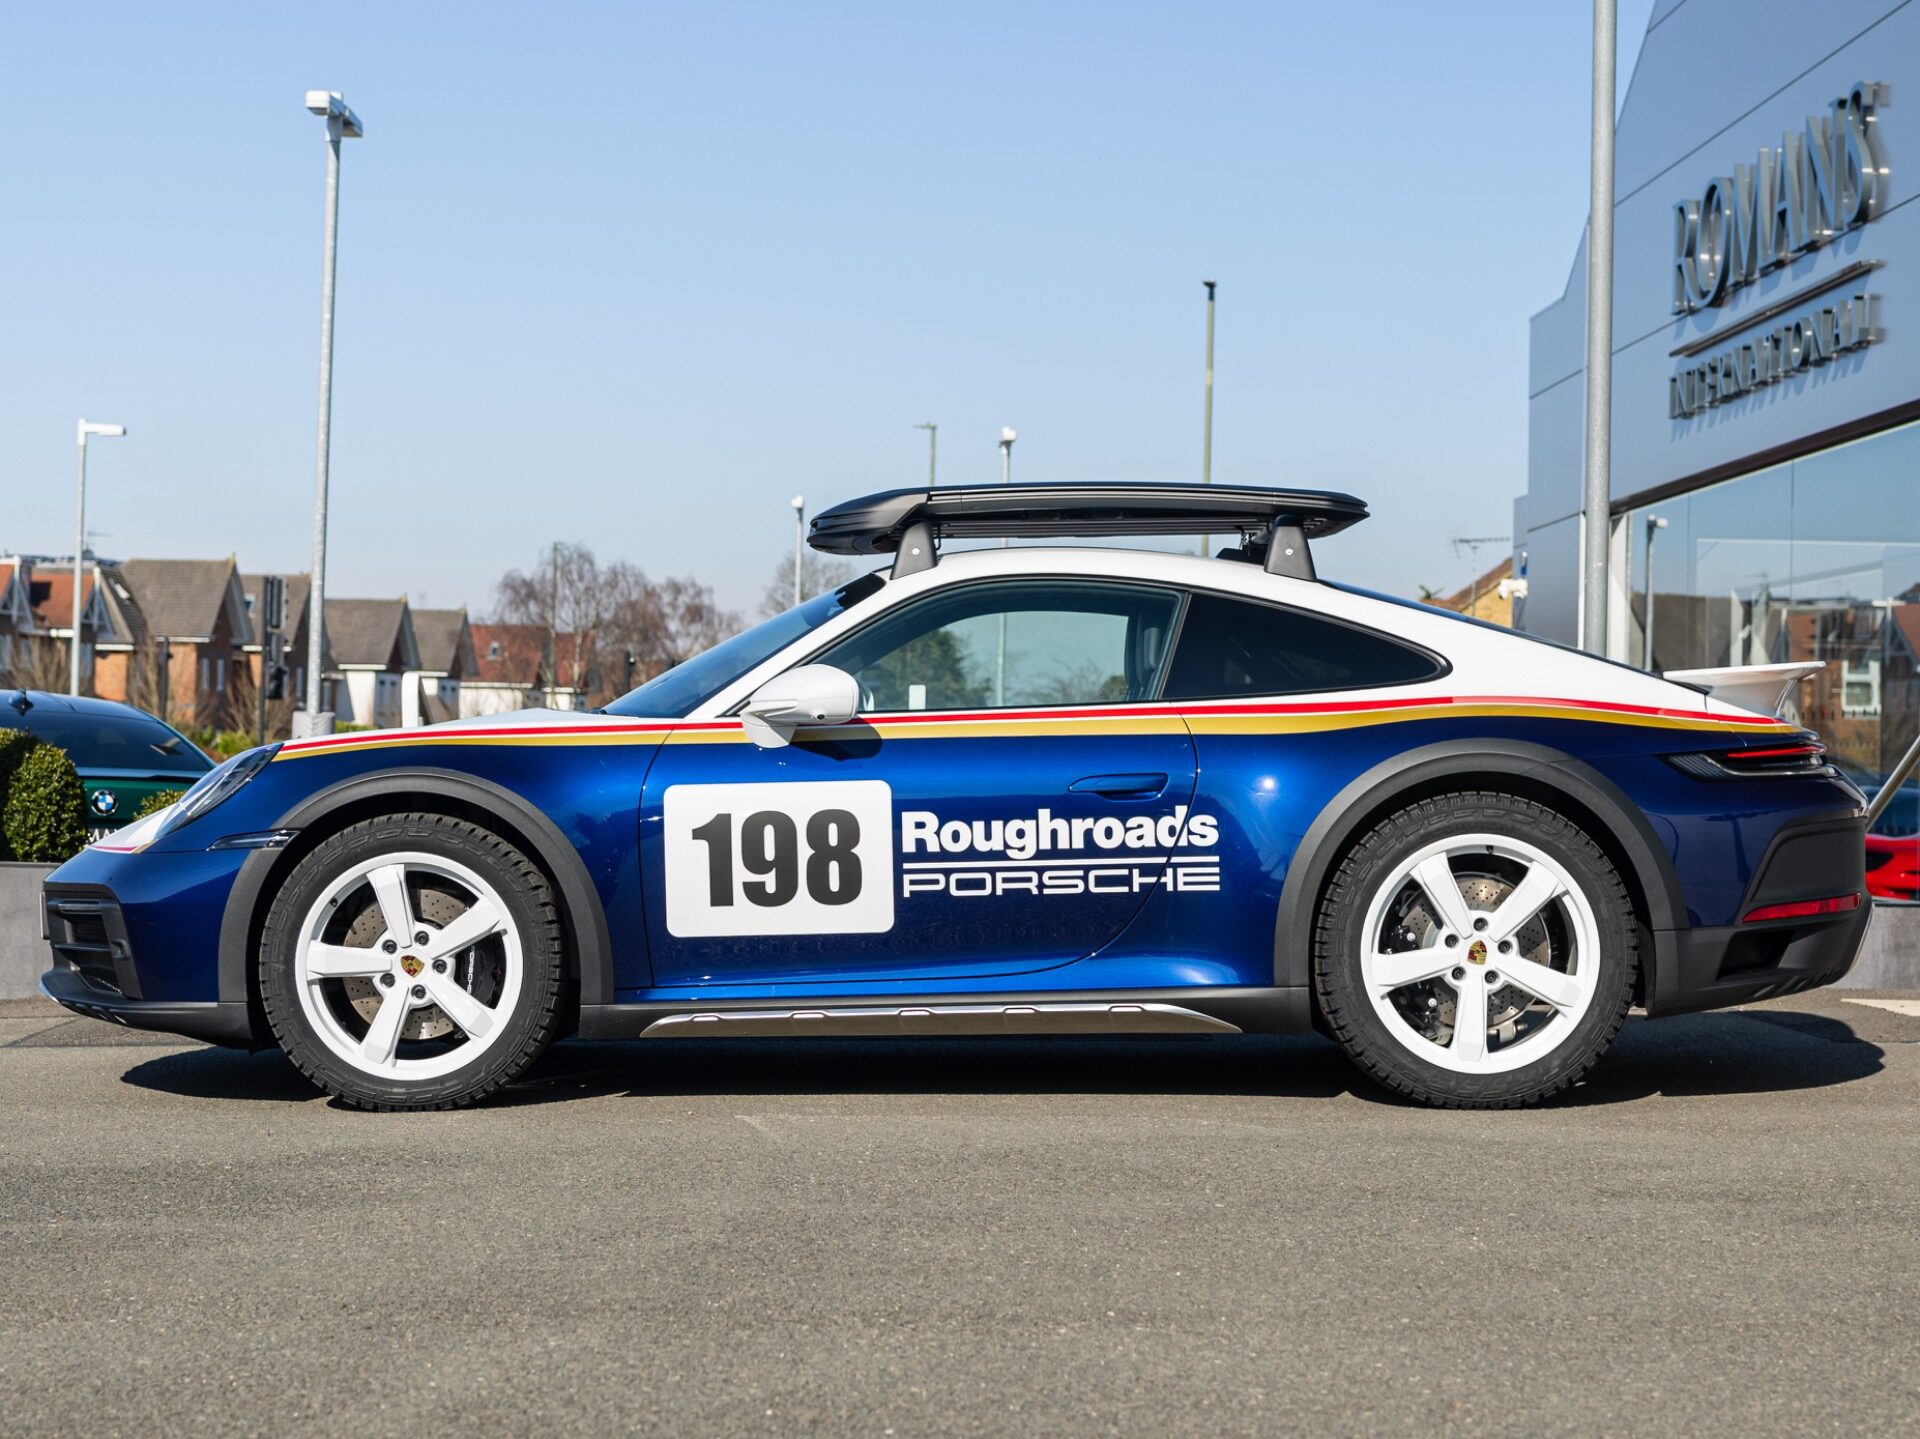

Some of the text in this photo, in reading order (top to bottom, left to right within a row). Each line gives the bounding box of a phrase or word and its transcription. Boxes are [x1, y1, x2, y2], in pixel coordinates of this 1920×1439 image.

[1672, 80, 1880, 316] ROMANS
[1668, 294, 1879, 419] INTERNATIONAL
[691, 808, 863, 908] 198
[901, 805, 1219, 859] Roughroads
[903, 866, 1221, 898] PORSCHE
